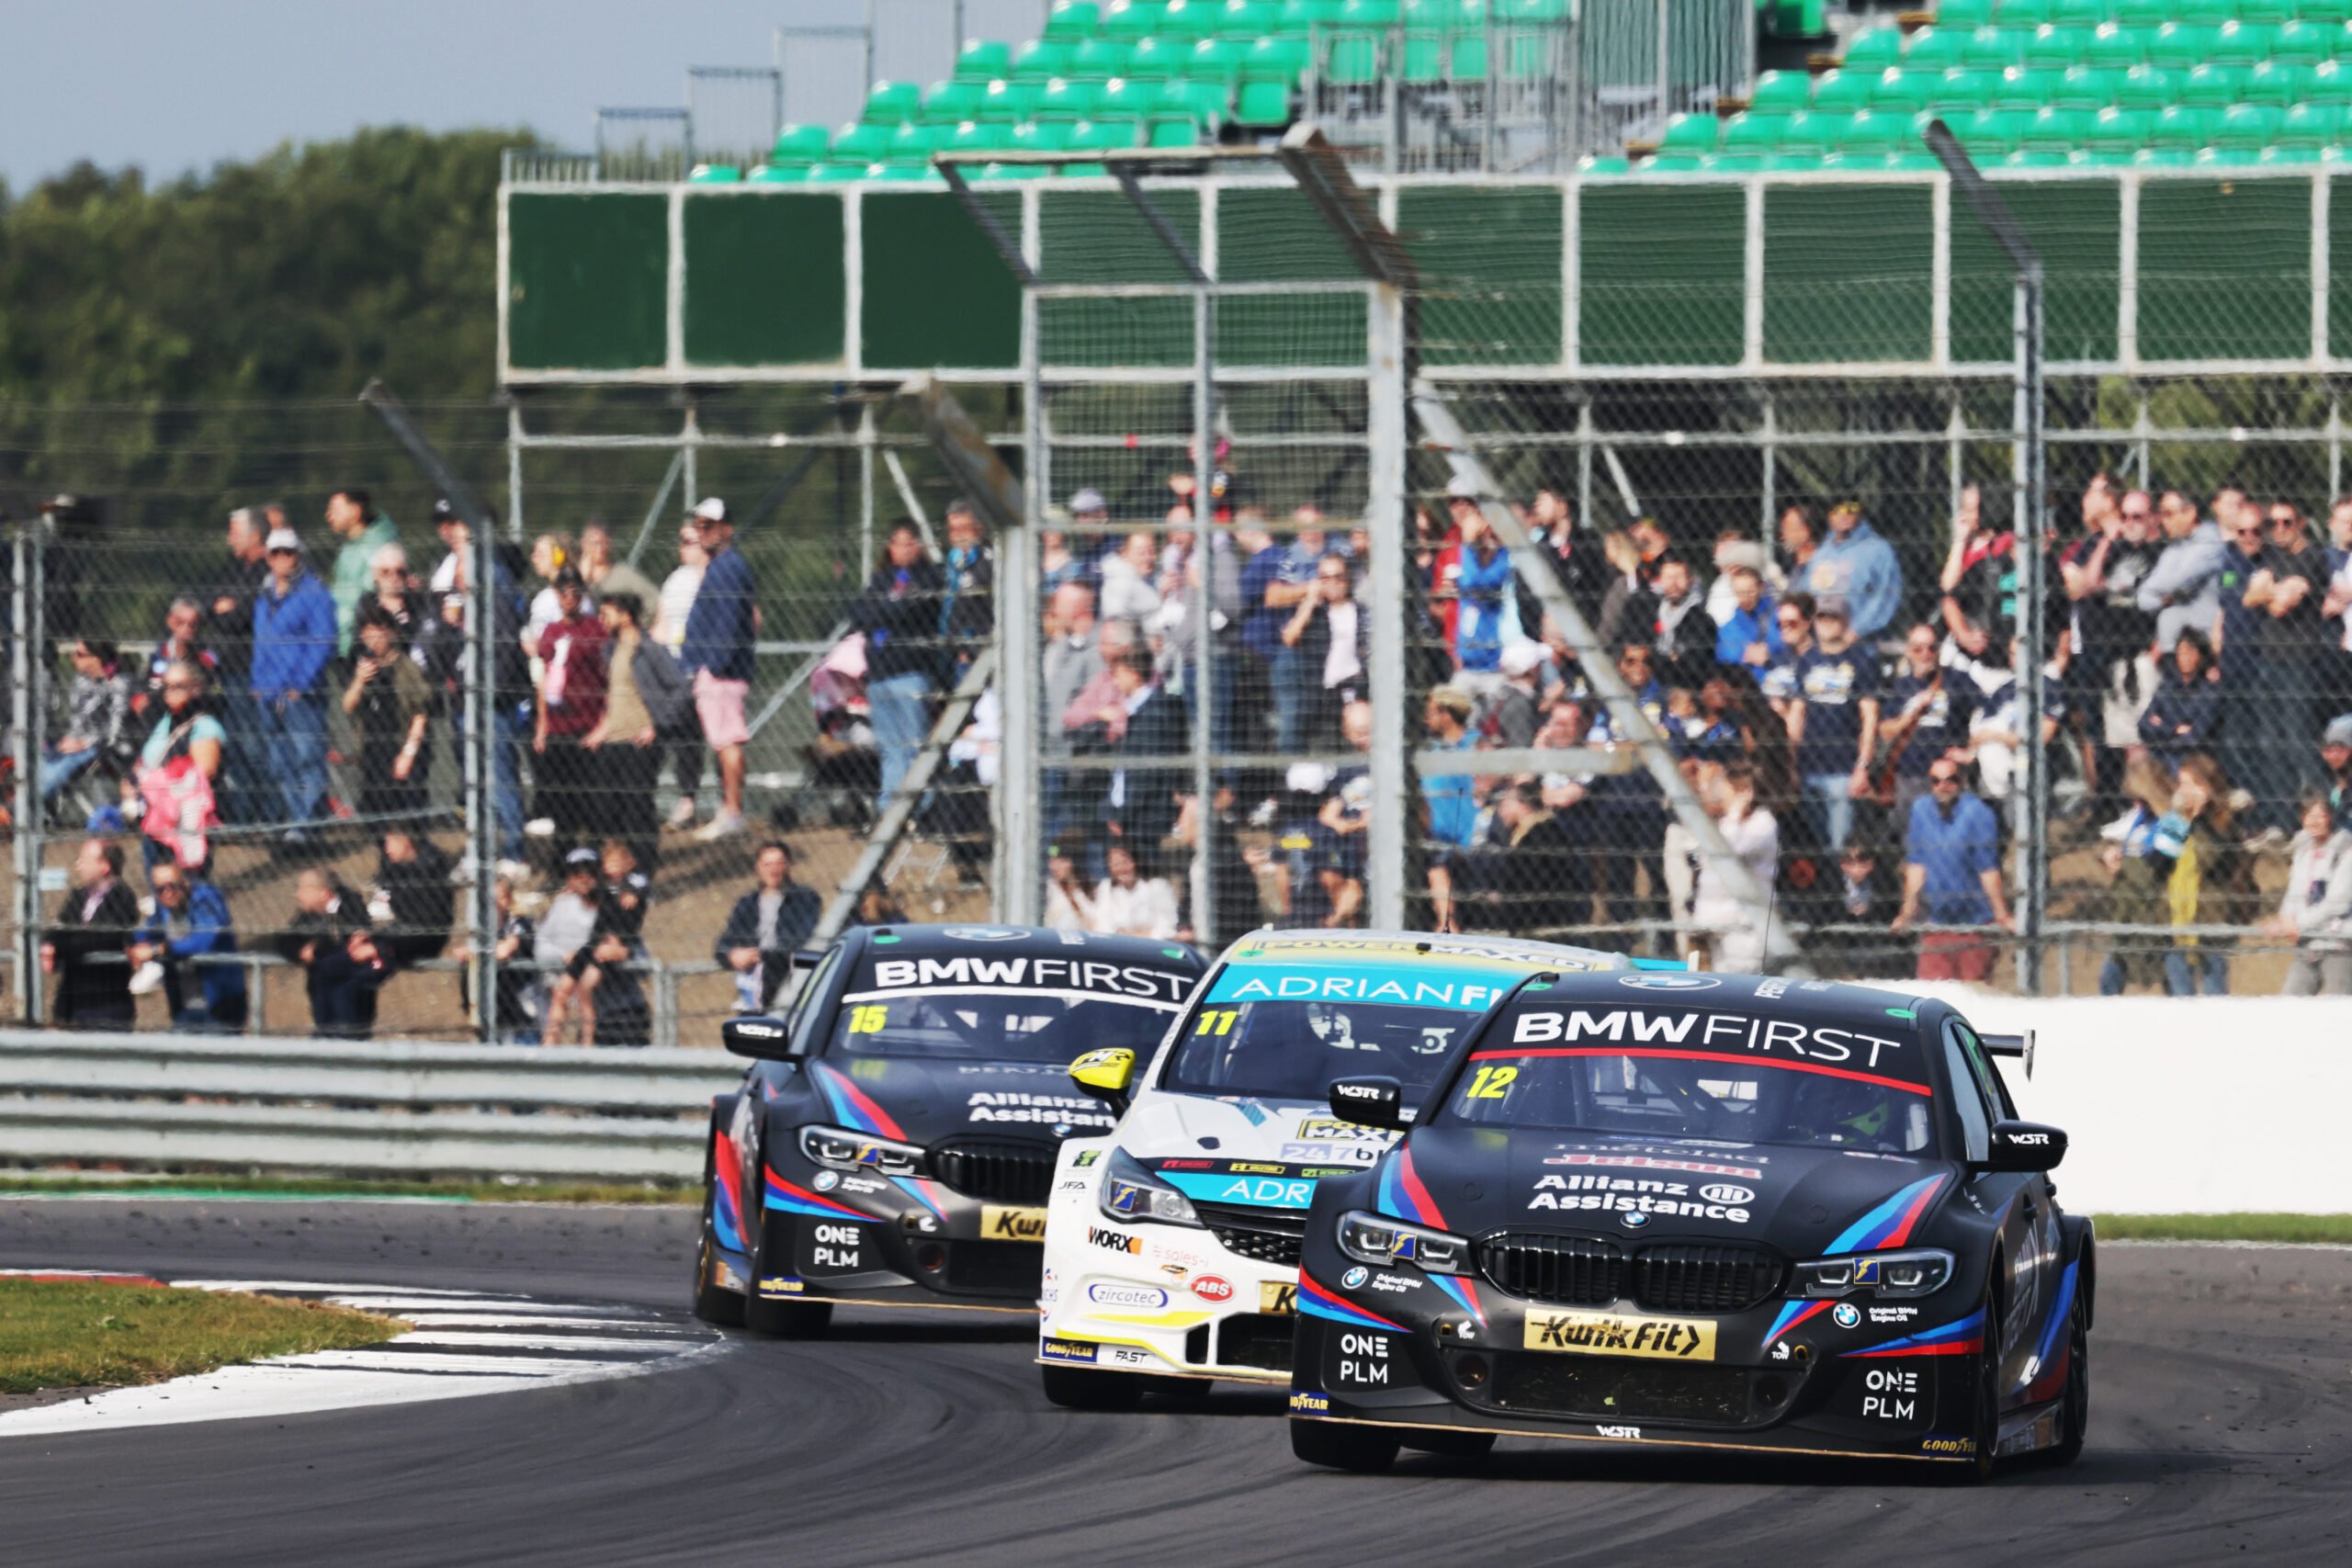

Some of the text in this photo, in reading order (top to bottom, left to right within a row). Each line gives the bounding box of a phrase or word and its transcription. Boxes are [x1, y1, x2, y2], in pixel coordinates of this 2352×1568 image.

[848, 1005, 888, 1033] 15
[1194, 1010, 1239, 1036] 11
[1336, 1084, 1380, 1100] WSR
[1466, 1066, 1519, 1099] 12
[967, 1091, 1098, 1111] Allianz
[2007, 1134, 2051, 1145] WSR
[1057, 1181, 1086, 1190] JFA
[1532, 1175, 1690, 1197] Allianz
[1527, 1192, 1750, 1224] Assistance
[815, 1224, 860, 1246] ONE
[1088, 1226, 1134, 1254] WORX
[814, 1247, 859, 1268] PLM
[1097, 1288, 1157, 1304] zircotec
[1194, 1281, 1229, 1297] ABS
[1458, 1330, 1476, 1339] TOW
[1045, 1340, 1094, 1358] GOODYEAR
[1340, 1334, 1388, 1358] ONE
[1771, 1351, 1790, 1360] TOW
[1340, 1360, 1388, 1384] PLM
[1866, 1370, 1917, 1393] ONE
[1863, 1396, 1915, 1420] PLM
[1596, 1425, 1641, 1438] WSR
